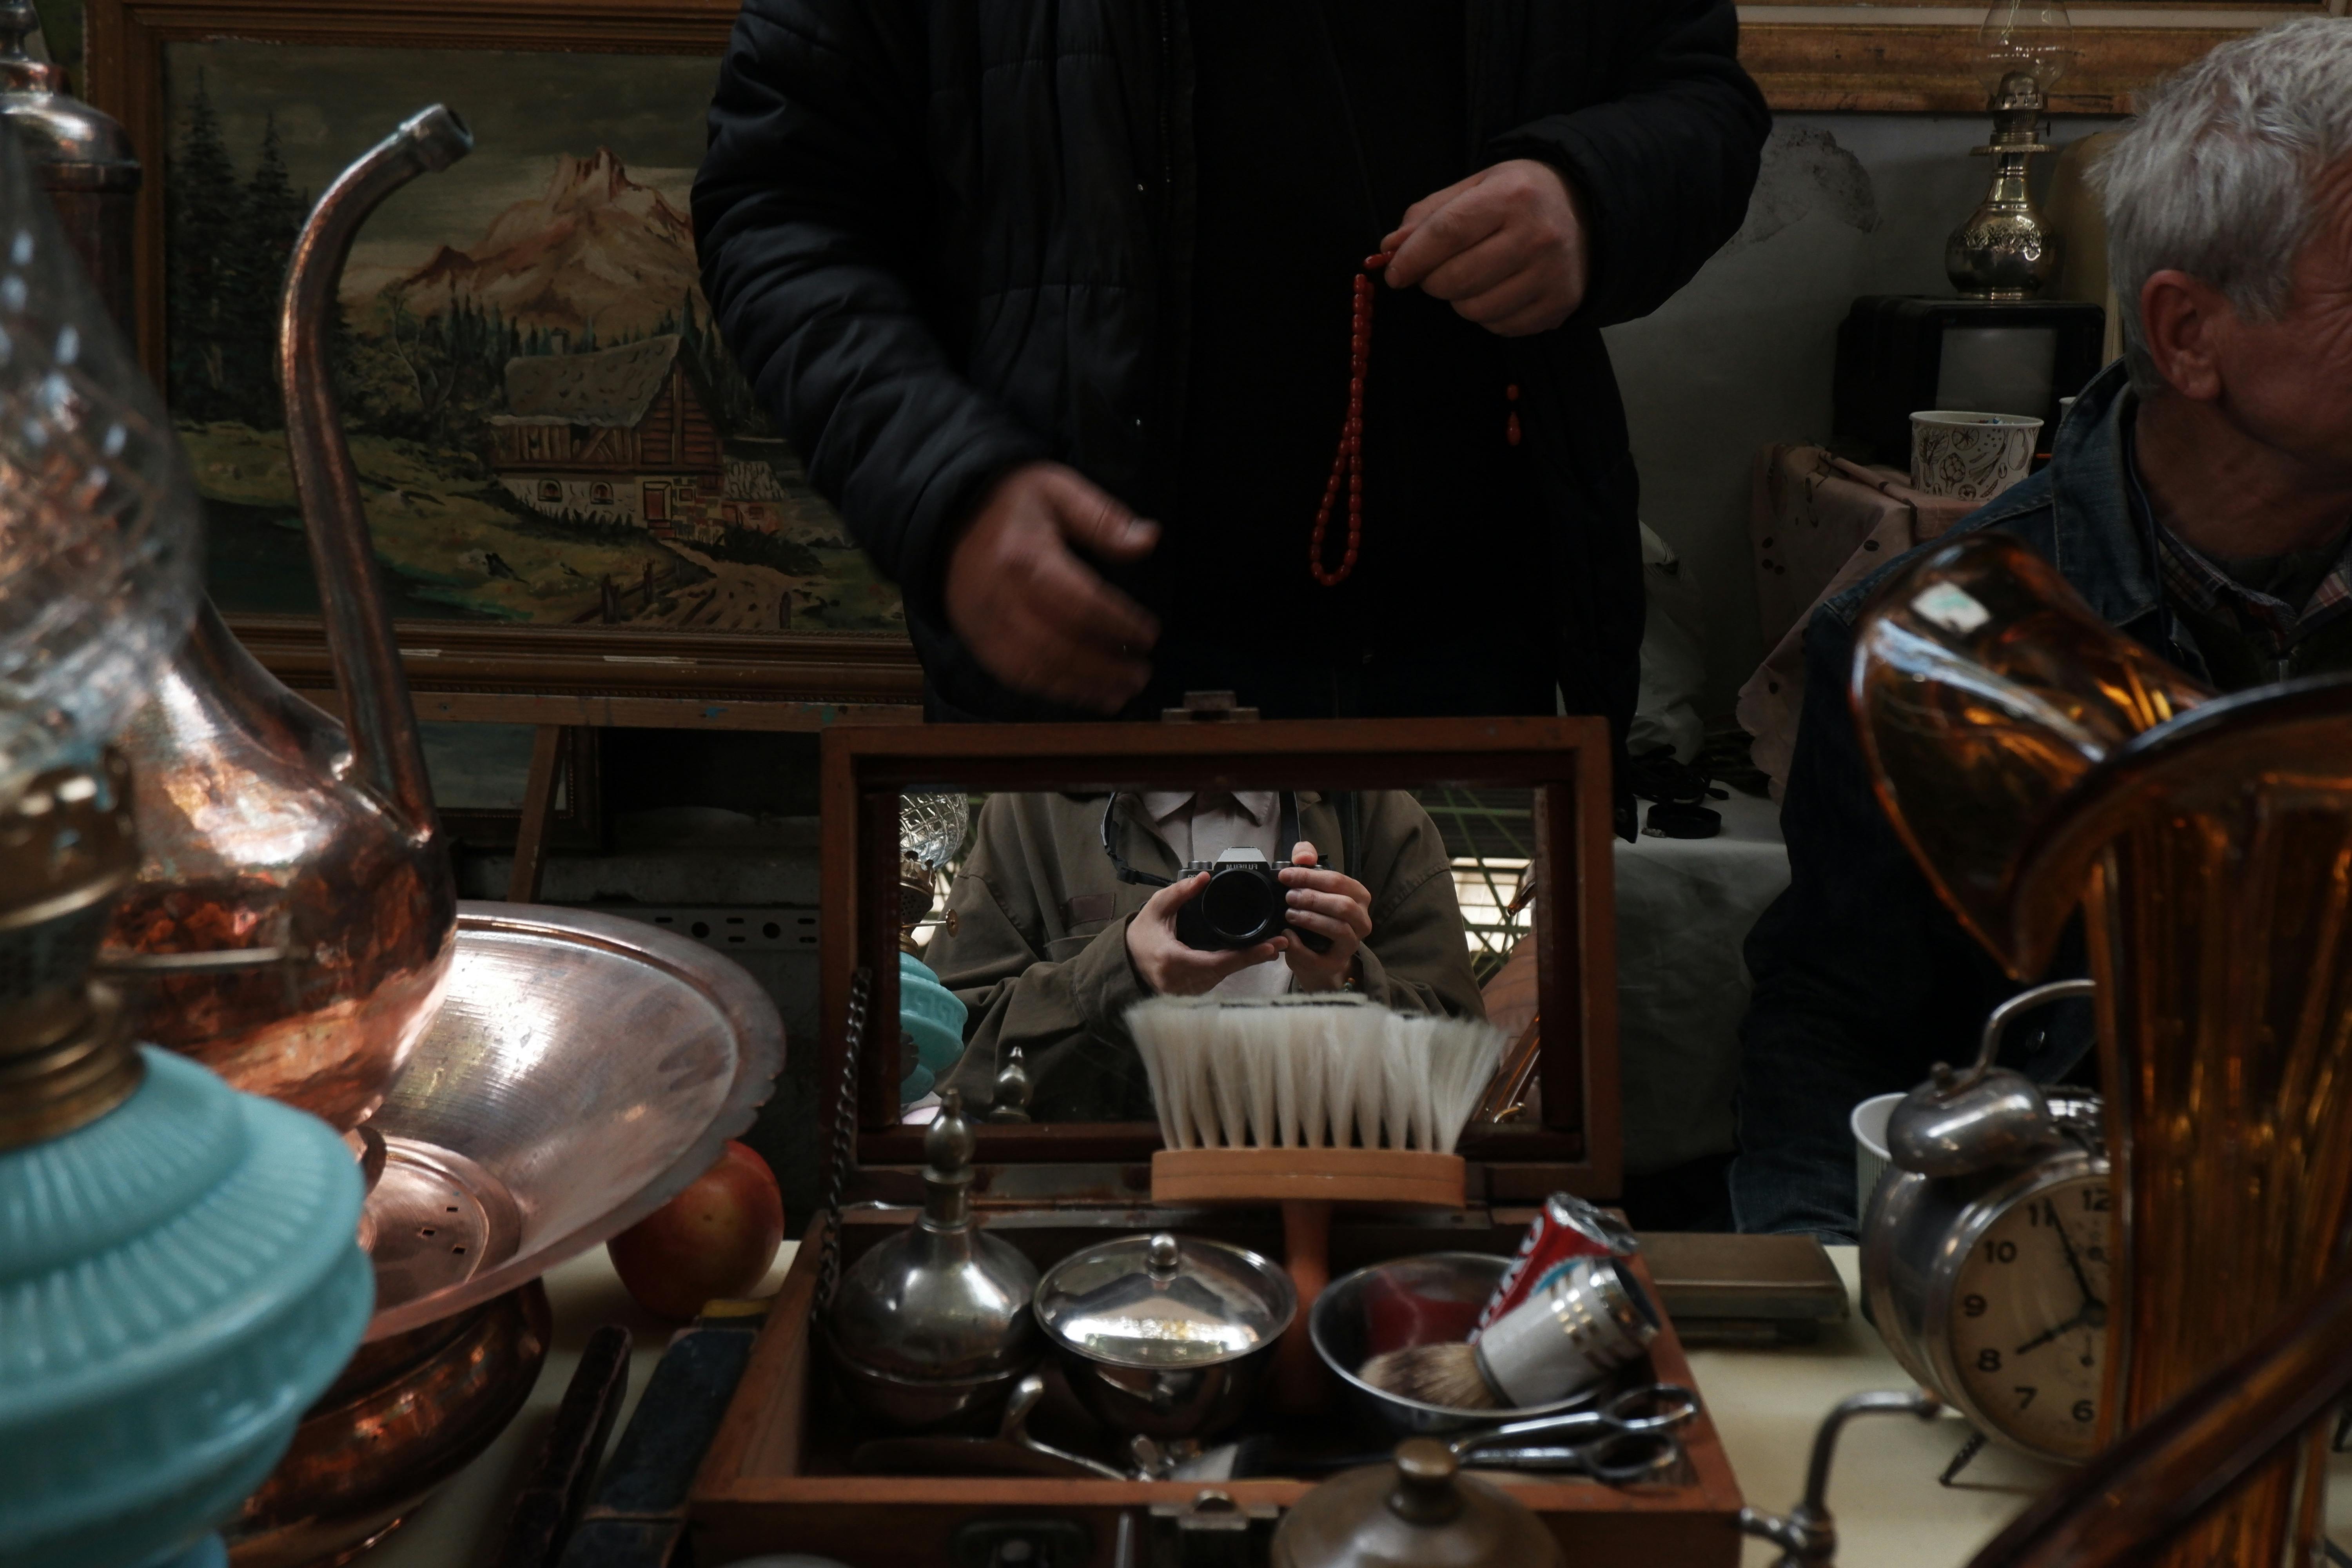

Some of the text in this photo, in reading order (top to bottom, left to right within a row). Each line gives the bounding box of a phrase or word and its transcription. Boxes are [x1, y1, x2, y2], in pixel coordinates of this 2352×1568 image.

[2083, 1189, 2111, 1212] 12
[2030, 1204, 2055, 1227] 11
[1986, 1241, 2017, 1263] 10
[1964, 1295, 1987, 1316] 9
[1978, 1349, 2002, 1371] 8
[2015, 1387, 2038, 1409] 7
[2073, 1400, 2094, 1422] 6
